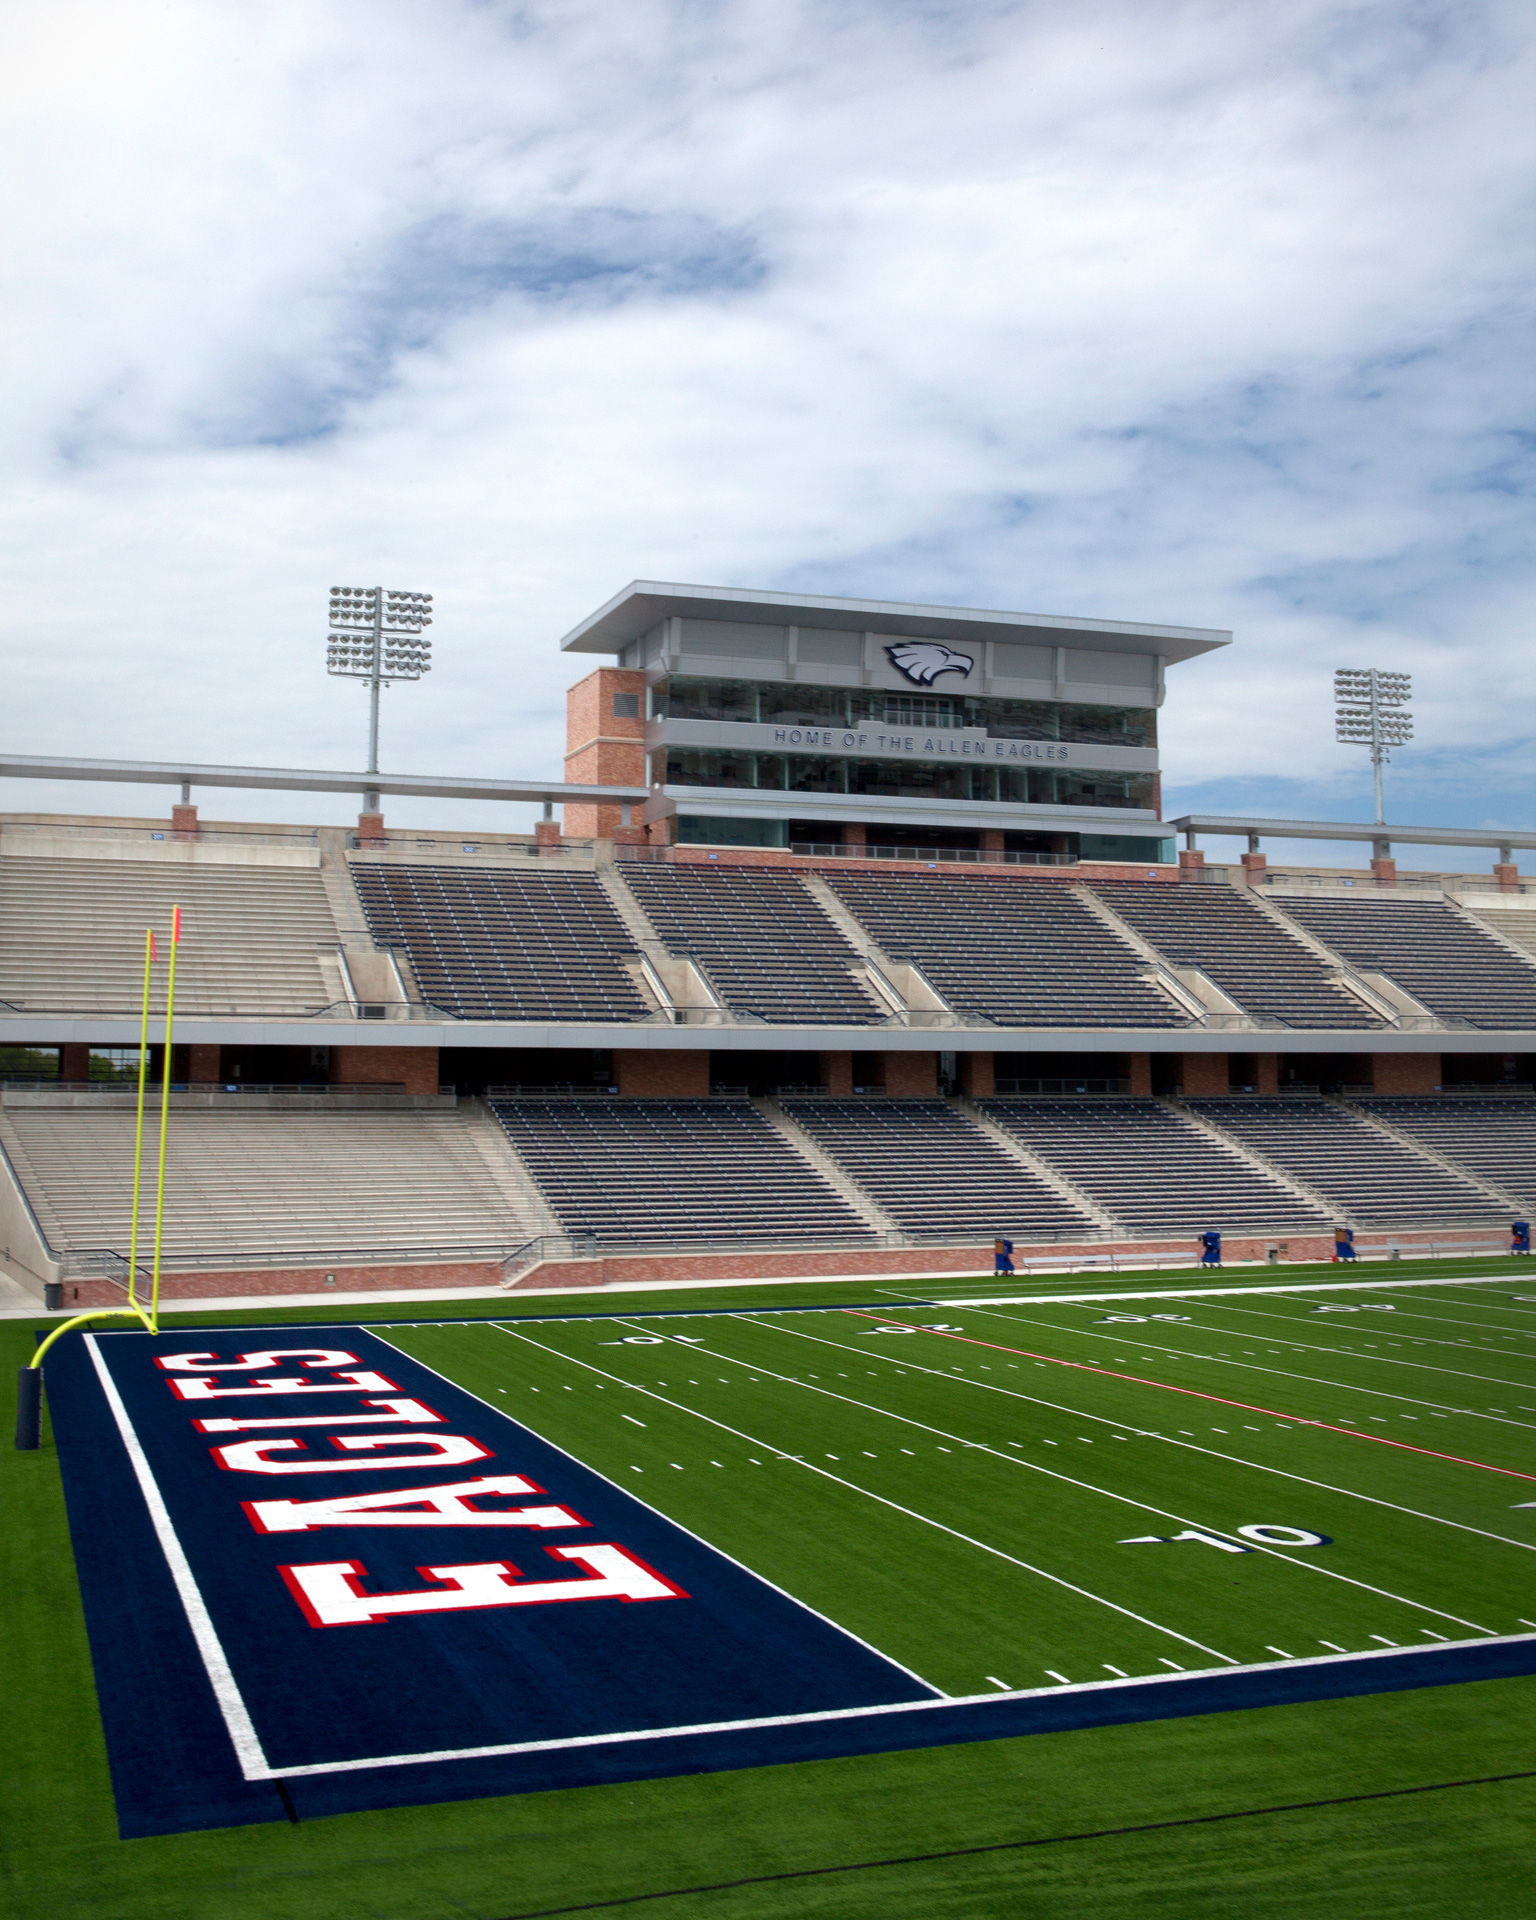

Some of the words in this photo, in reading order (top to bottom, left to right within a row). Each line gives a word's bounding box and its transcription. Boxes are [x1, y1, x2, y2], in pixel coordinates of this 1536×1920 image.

[774, 729, 833, 746] HOME
[843, 733, 868, 748] OF
[877, 735, 915, 751] THE
[924, 738, 986, 756] ALLEN
[996, 742, 1070, 760] EAGLES
[152, 1348, 692, 1628] EAGLES
[1171, 1524, 1334, 1553] 10
